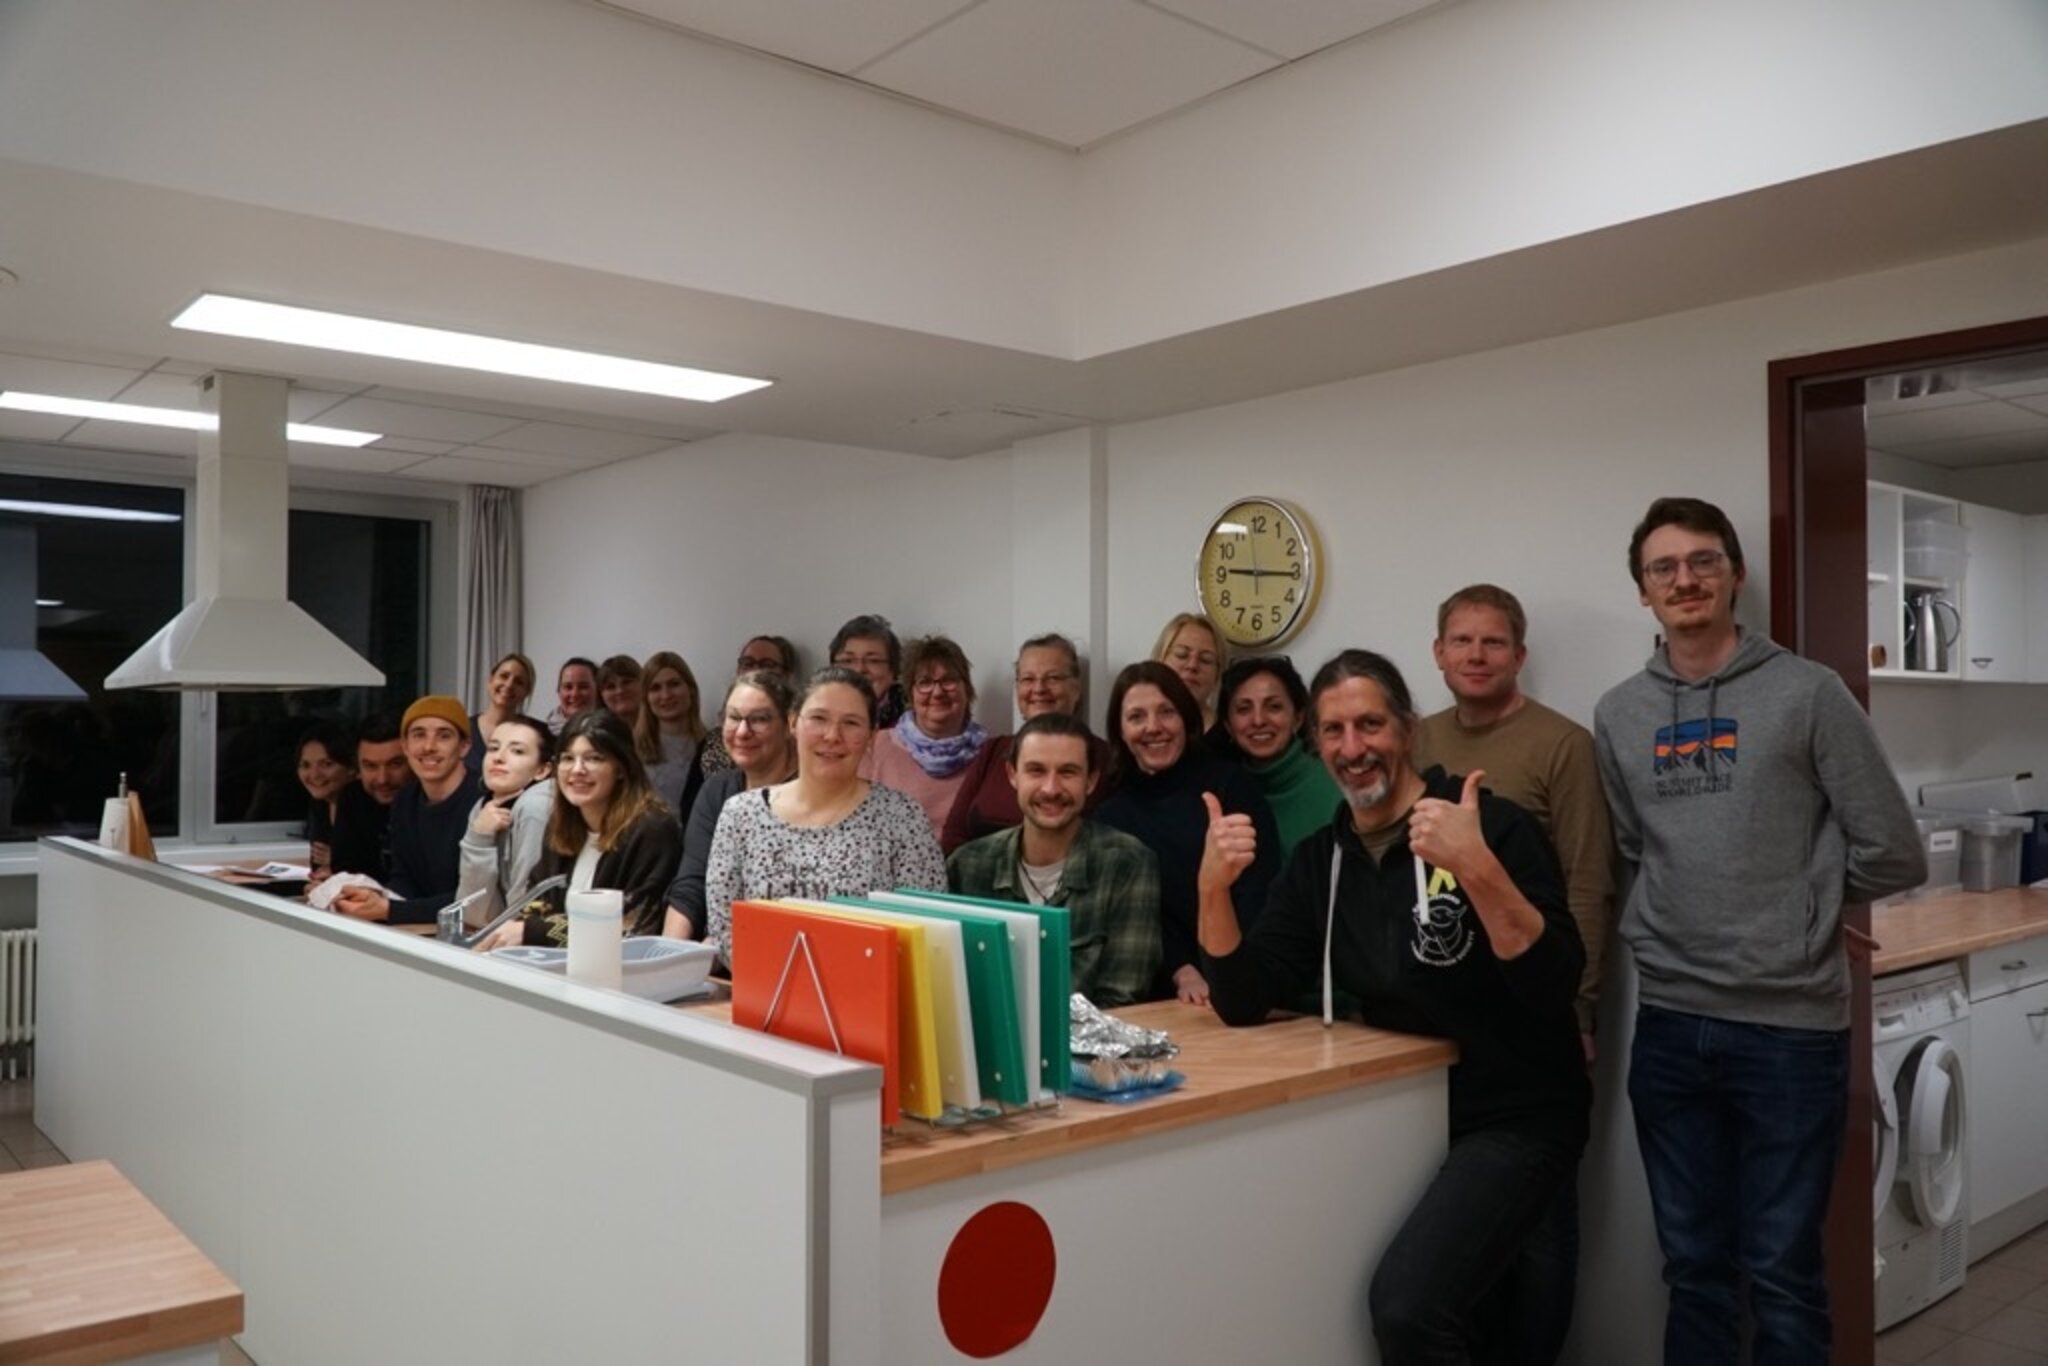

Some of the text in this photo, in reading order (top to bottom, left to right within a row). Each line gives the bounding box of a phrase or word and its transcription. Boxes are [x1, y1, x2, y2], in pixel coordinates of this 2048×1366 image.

[1252, 516, 1266, 533] 12
[1275, 522, 1281, 538] 1
[1219, 543, 1234, 560] 10
[1286, 538, 1297, 556] 2
[1216, 566, 1227, 584] 9
[1291, 562, 1301, 580] 3
[1220, 590, 1231, 608] 8
[1284, 588, 1295, 604] 4
[1235, 607, 1246, 624] 7
[1252, 613, 1262, 630] 6
[1271, 606, 1281, 623] 5
